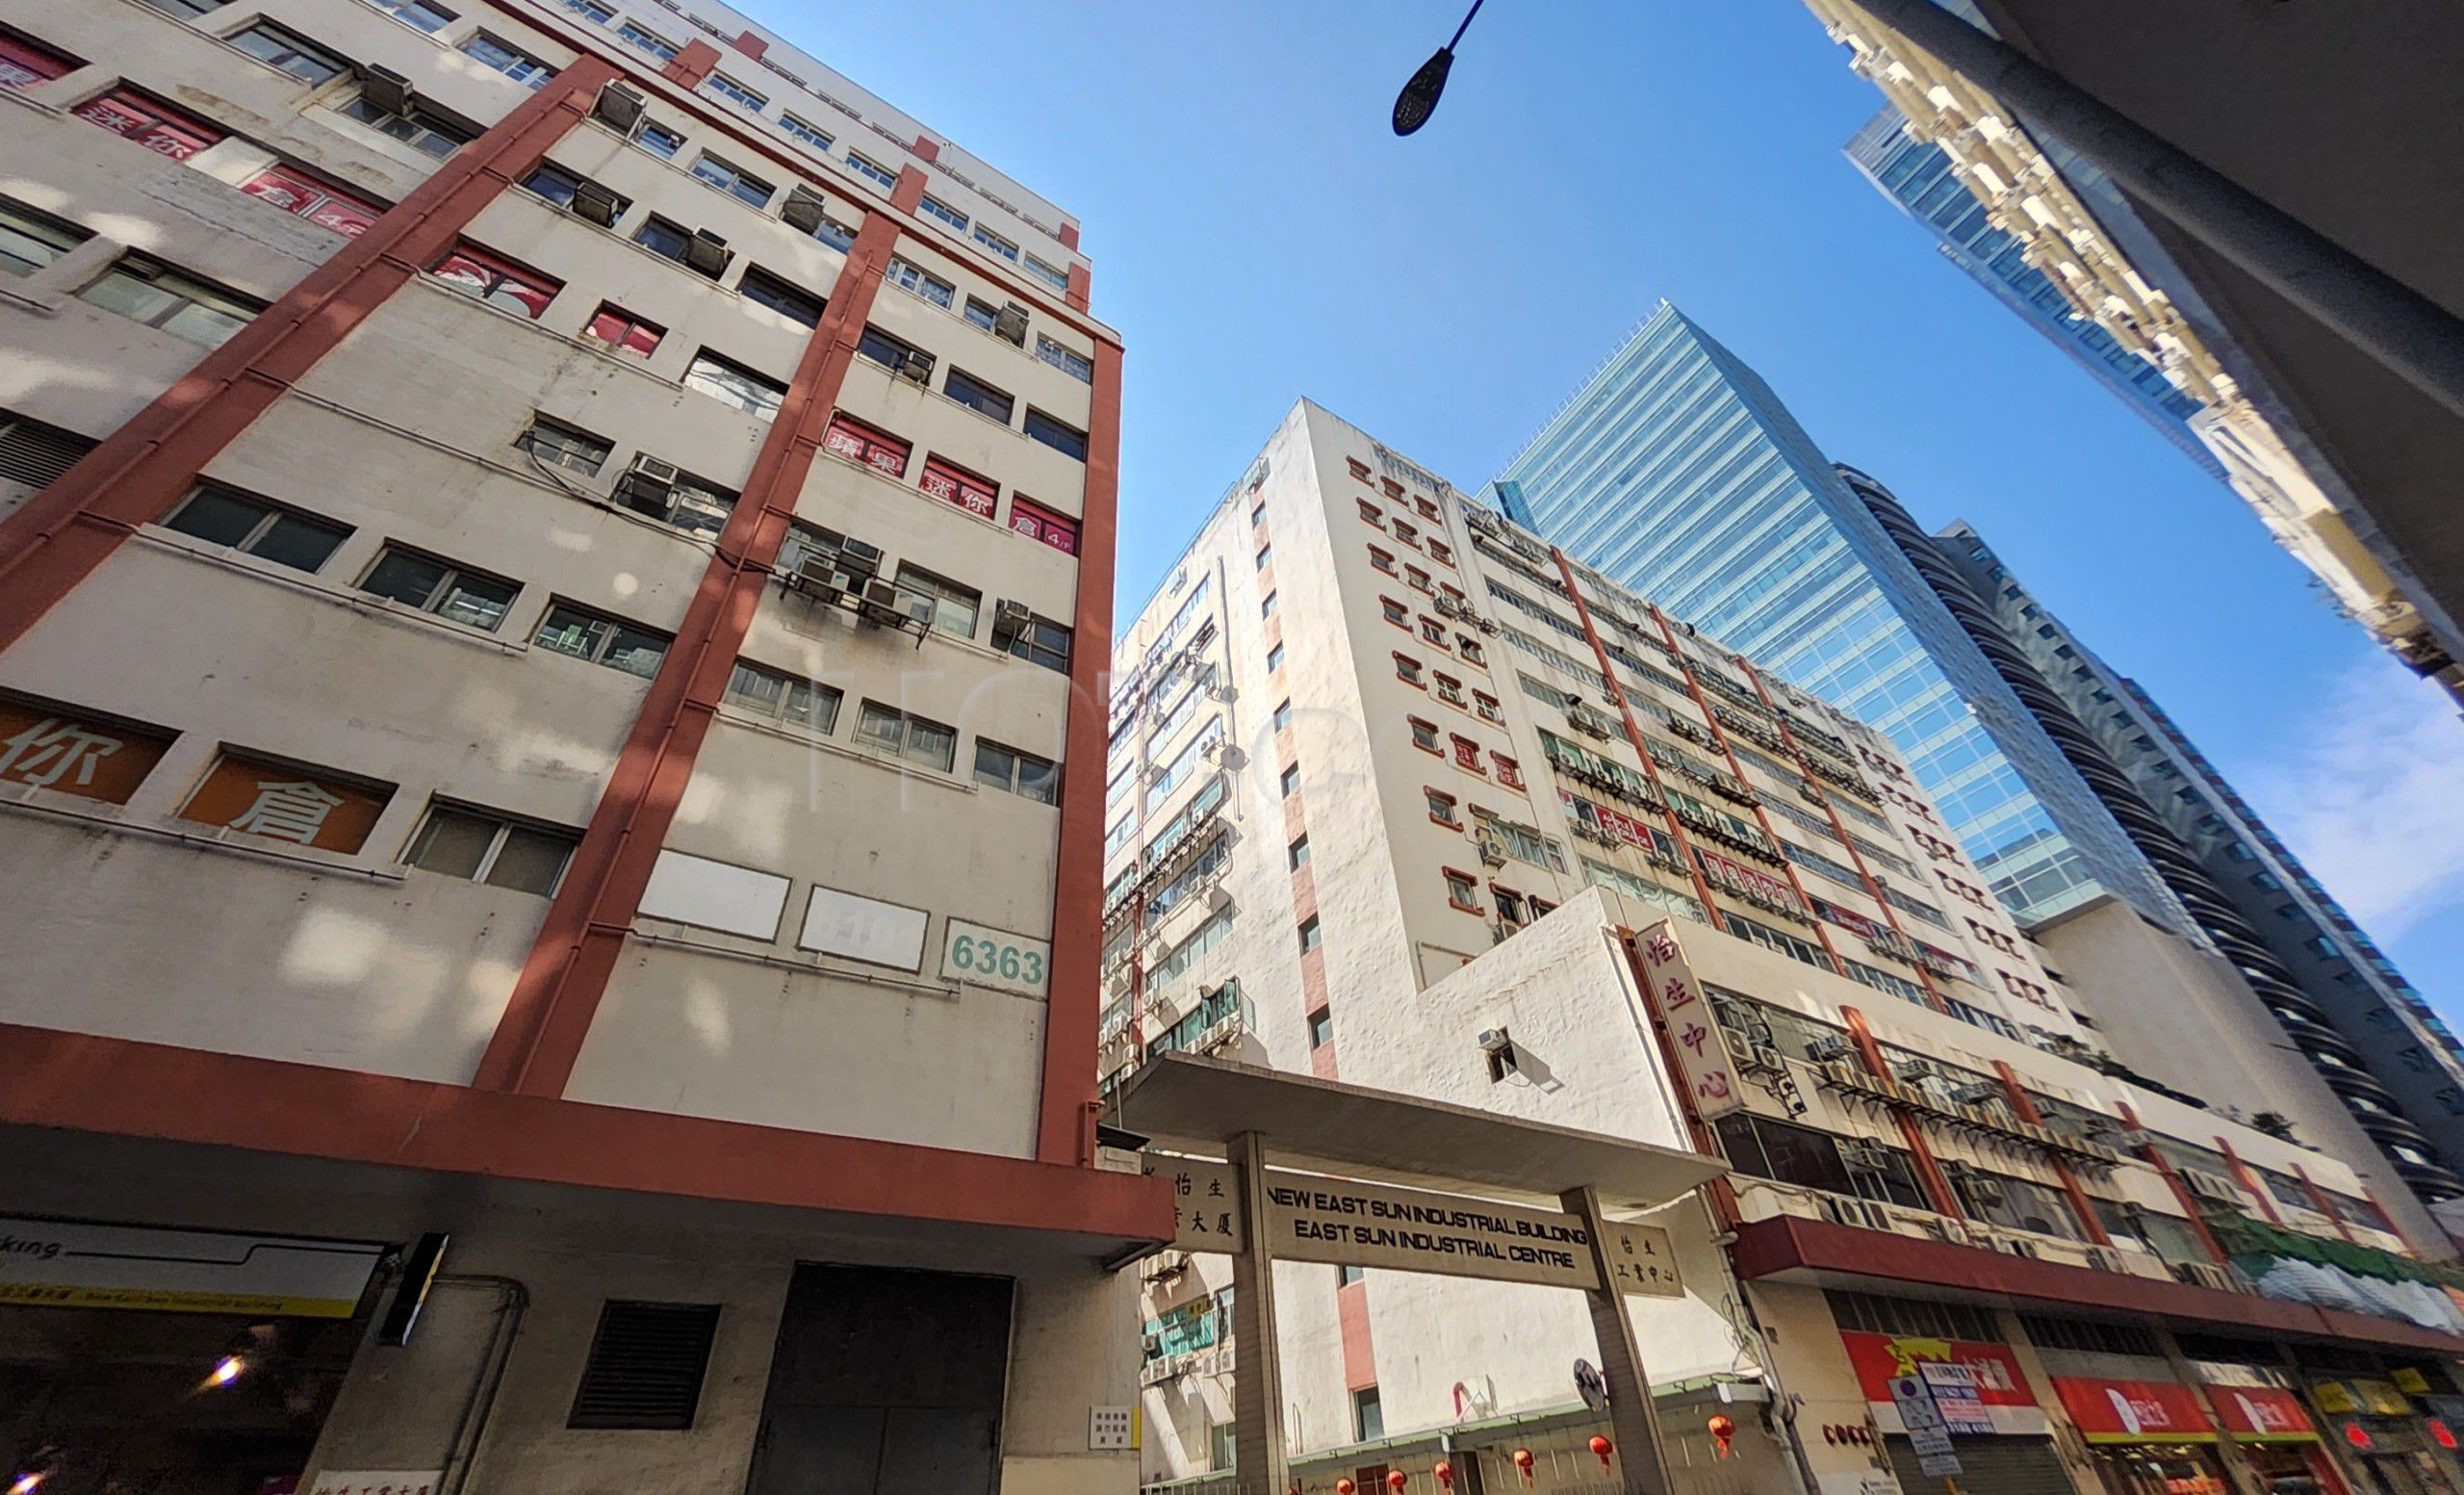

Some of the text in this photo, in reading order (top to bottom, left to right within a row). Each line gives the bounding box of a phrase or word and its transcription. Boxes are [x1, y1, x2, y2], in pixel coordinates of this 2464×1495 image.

[0, 719, 346, 845] 你 倉
[951, 935, 1042, 985] 6363
[1646, 933, 1730, 1098] 怡生中心
[1267, 1187, 1588, 1246] NEW EAST SUN INDUSTRIAL BUILDING
[0, 1234, 64, 1260] king
[1295, 1220, 1576, 1269] EAST SUN INDUSTRIAL CENTRE
